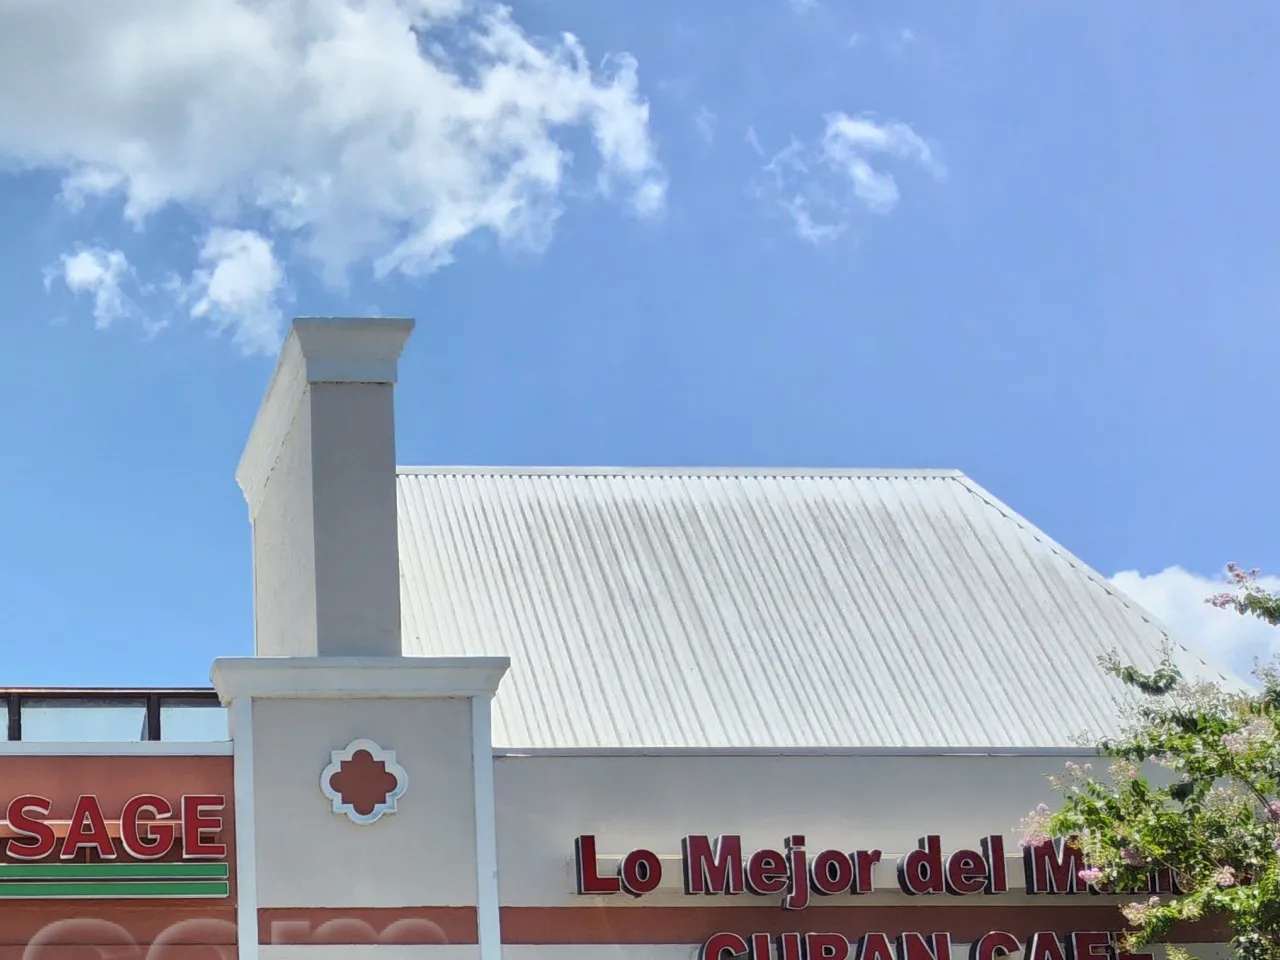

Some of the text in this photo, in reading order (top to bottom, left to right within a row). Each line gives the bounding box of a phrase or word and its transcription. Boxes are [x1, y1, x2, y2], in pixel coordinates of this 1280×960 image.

[575, 835, 662, 896] Lo
[682, 835, 881, 910] Mejor
[898, 835, 1009, 896] del
